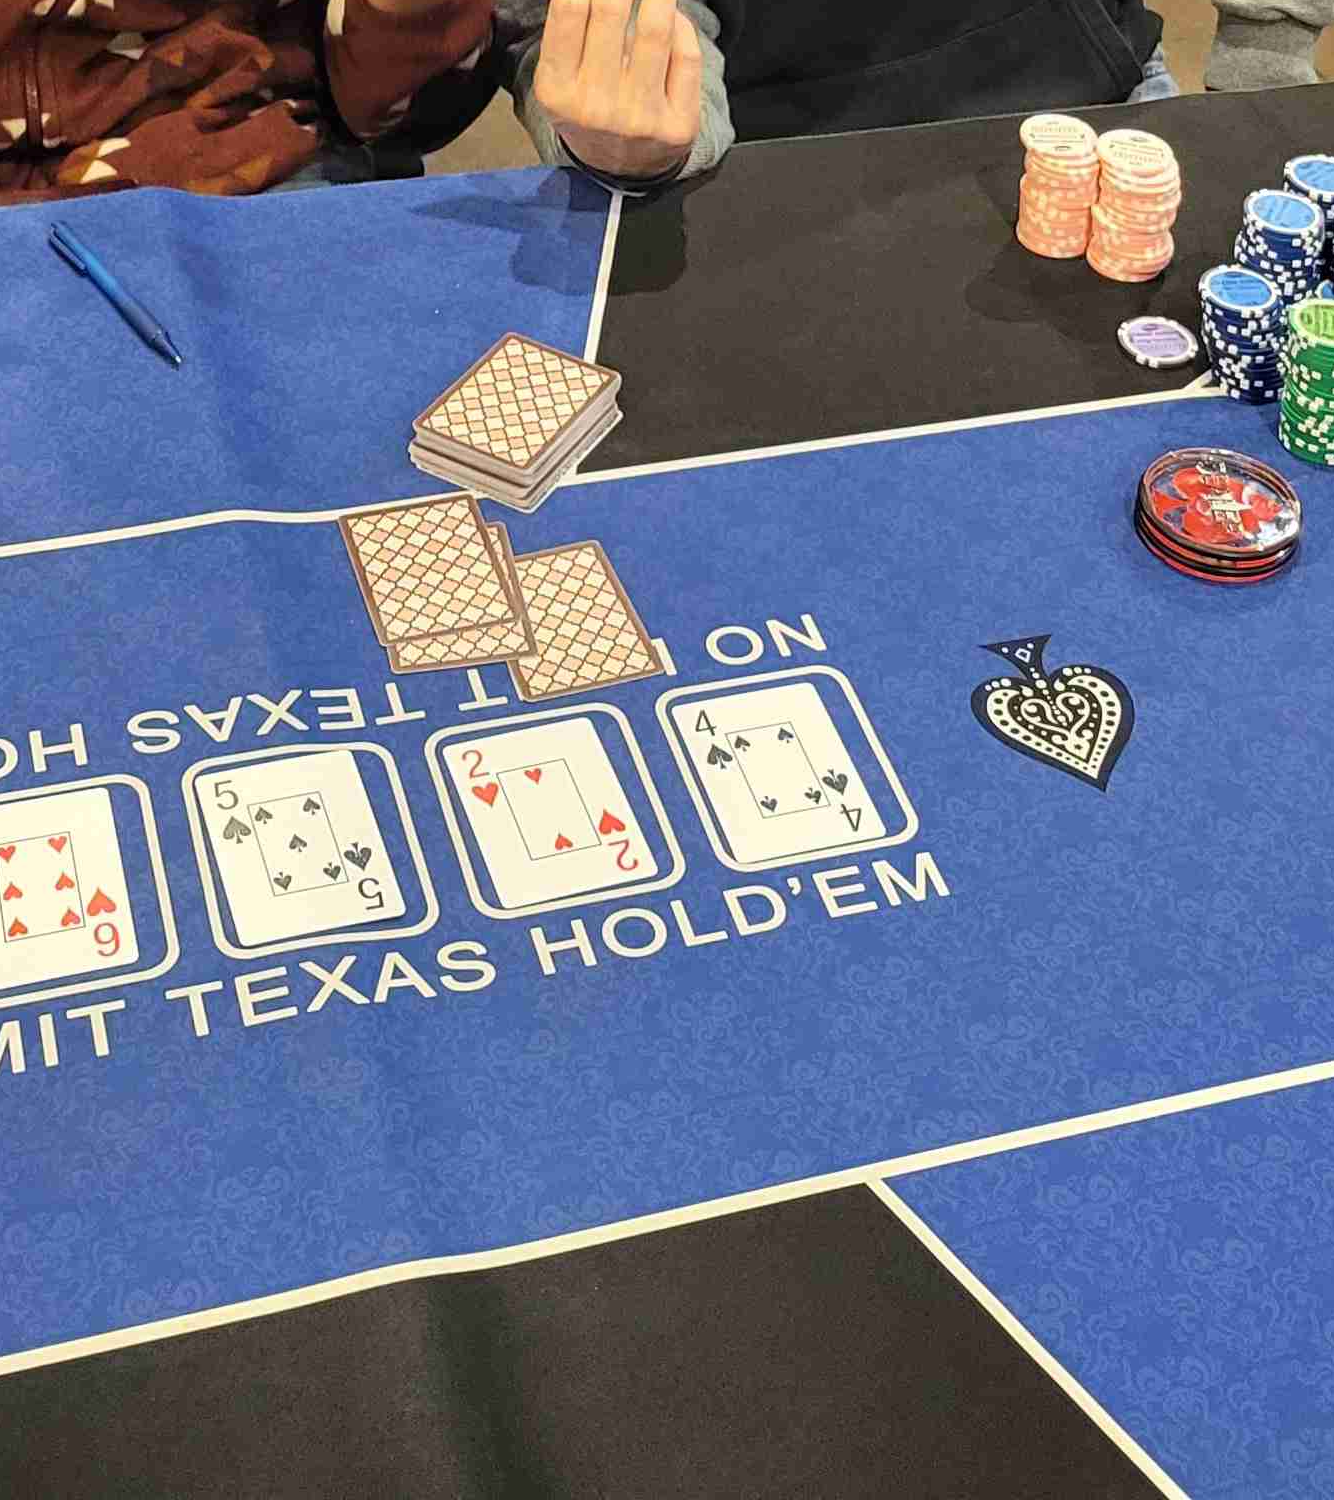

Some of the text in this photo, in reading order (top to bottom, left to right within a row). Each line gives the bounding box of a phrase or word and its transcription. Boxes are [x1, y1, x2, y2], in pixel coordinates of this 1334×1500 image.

[705, 613, 827, 665] NO
[126, 682, 426, 754] TEXAS
[695, 710, 718, 737] 4
[461, 749, 490, 779] 2
[214, 779, 239, 810] 5
[839, 804, 862, 832] 4
[608, 839, 639, 872] 2
[358, 877, 385, 910] 5
[165, 940, 497, 1037] TEXAS
[529, 851, 950, 976] HOLD'EM
